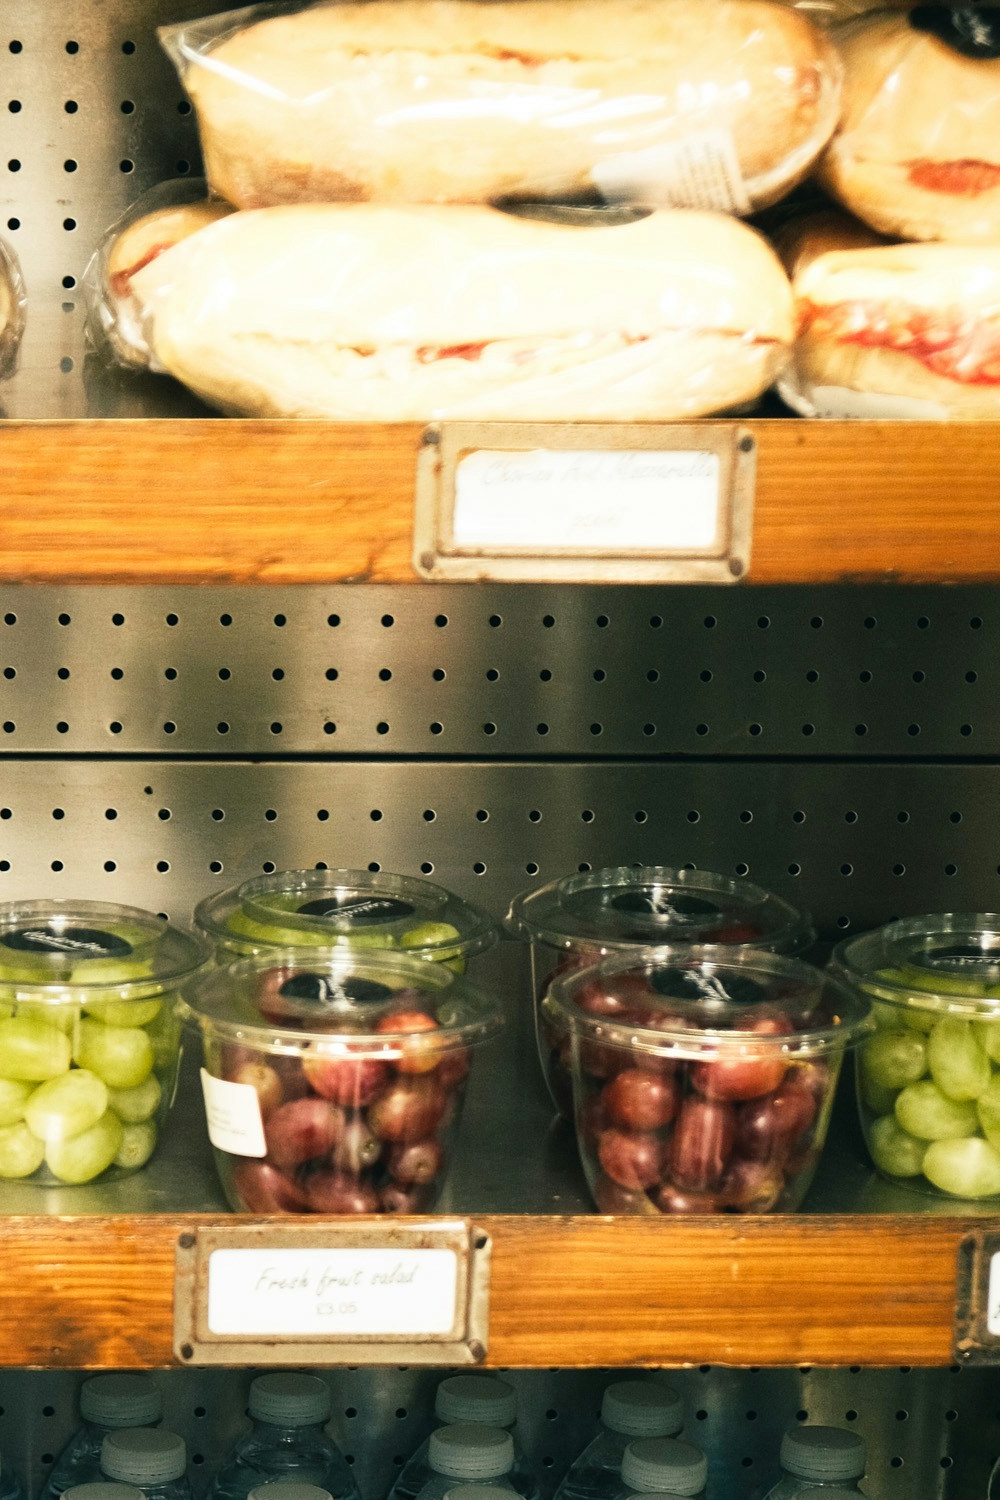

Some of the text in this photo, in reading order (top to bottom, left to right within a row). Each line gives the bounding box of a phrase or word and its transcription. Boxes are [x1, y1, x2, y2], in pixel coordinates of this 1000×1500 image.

[253, 1260, 421, 1297] Fresh fruit salad
